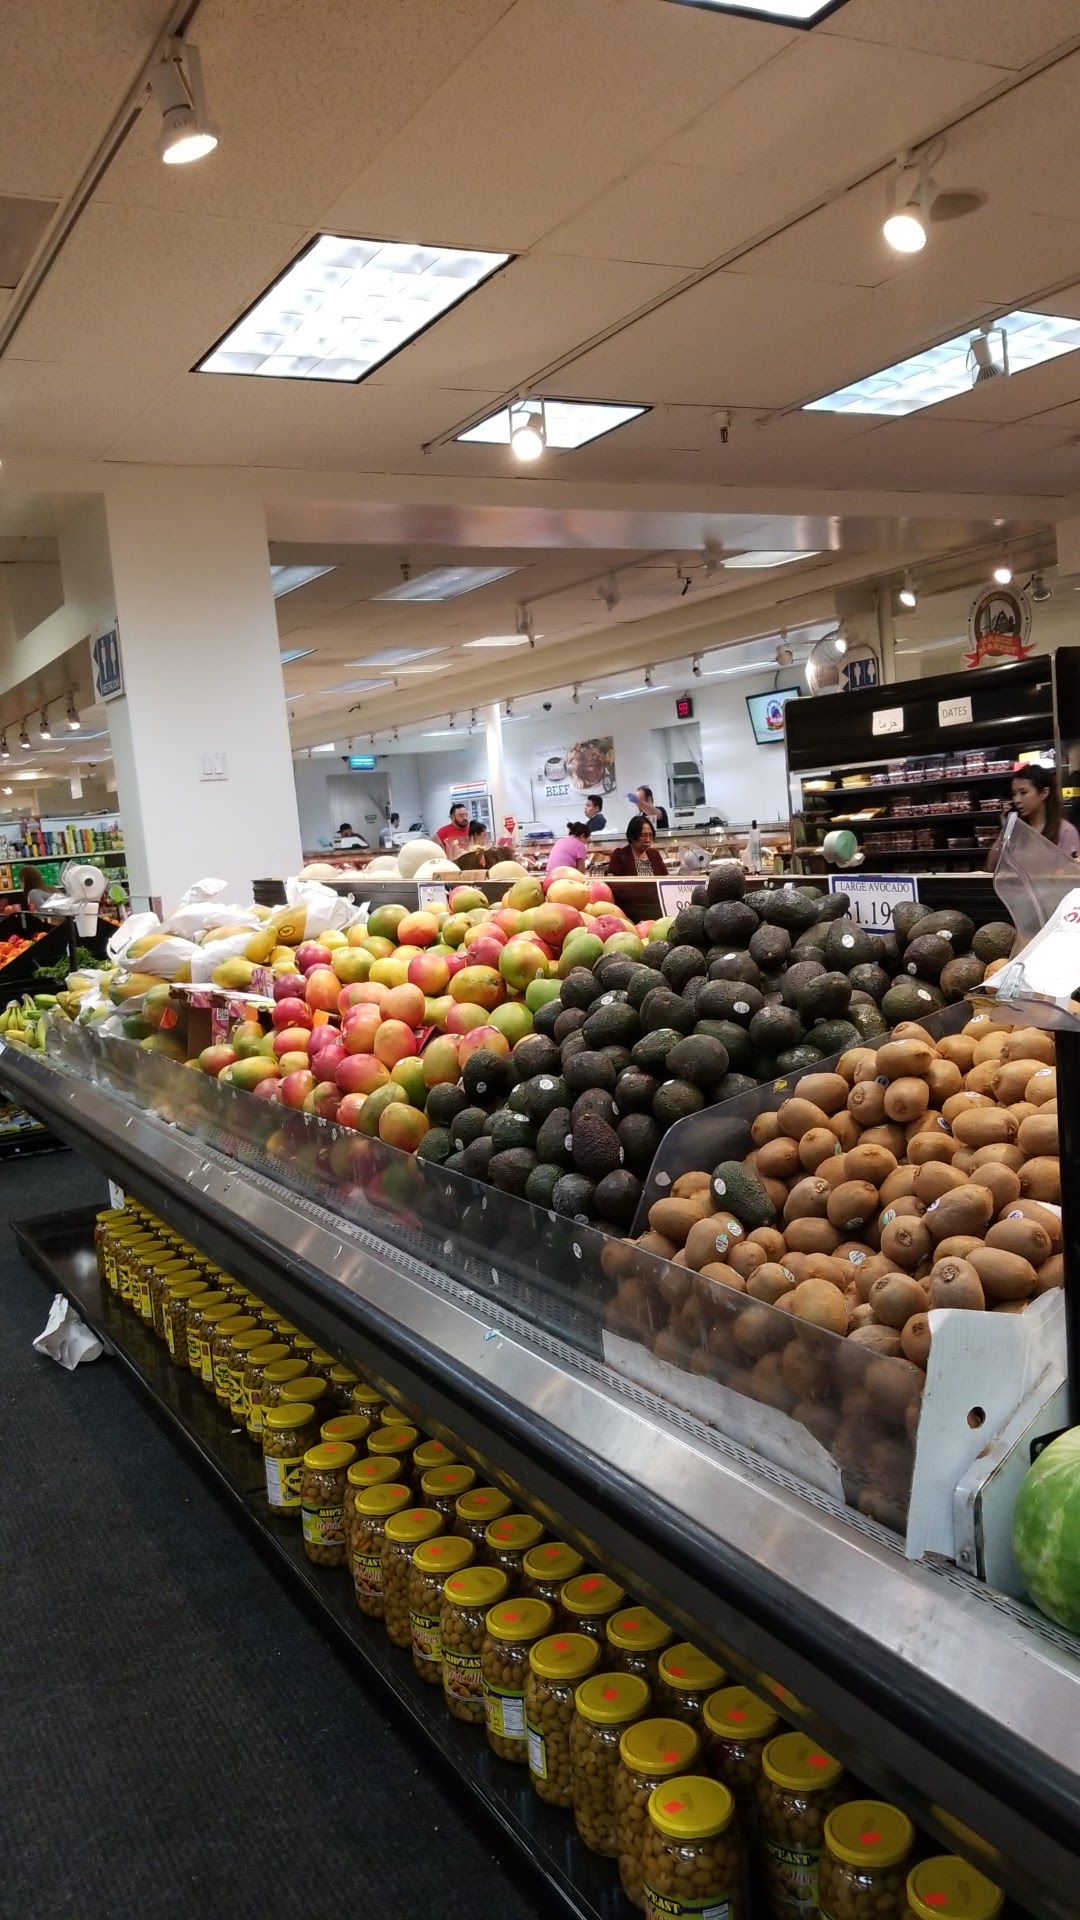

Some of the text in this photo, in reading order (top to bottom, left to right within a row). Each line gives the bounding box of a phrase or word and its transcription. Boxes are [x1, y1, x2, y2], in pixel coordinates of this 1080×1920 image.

[942, 706, 967, 719] DATES
[545, 784, 571, 798] BEEF
[677, 885, 695, 893] MANG
[840, 881, 909, 893] LARGE AVOCADO
[846, 900, 891, 926] 1.19
